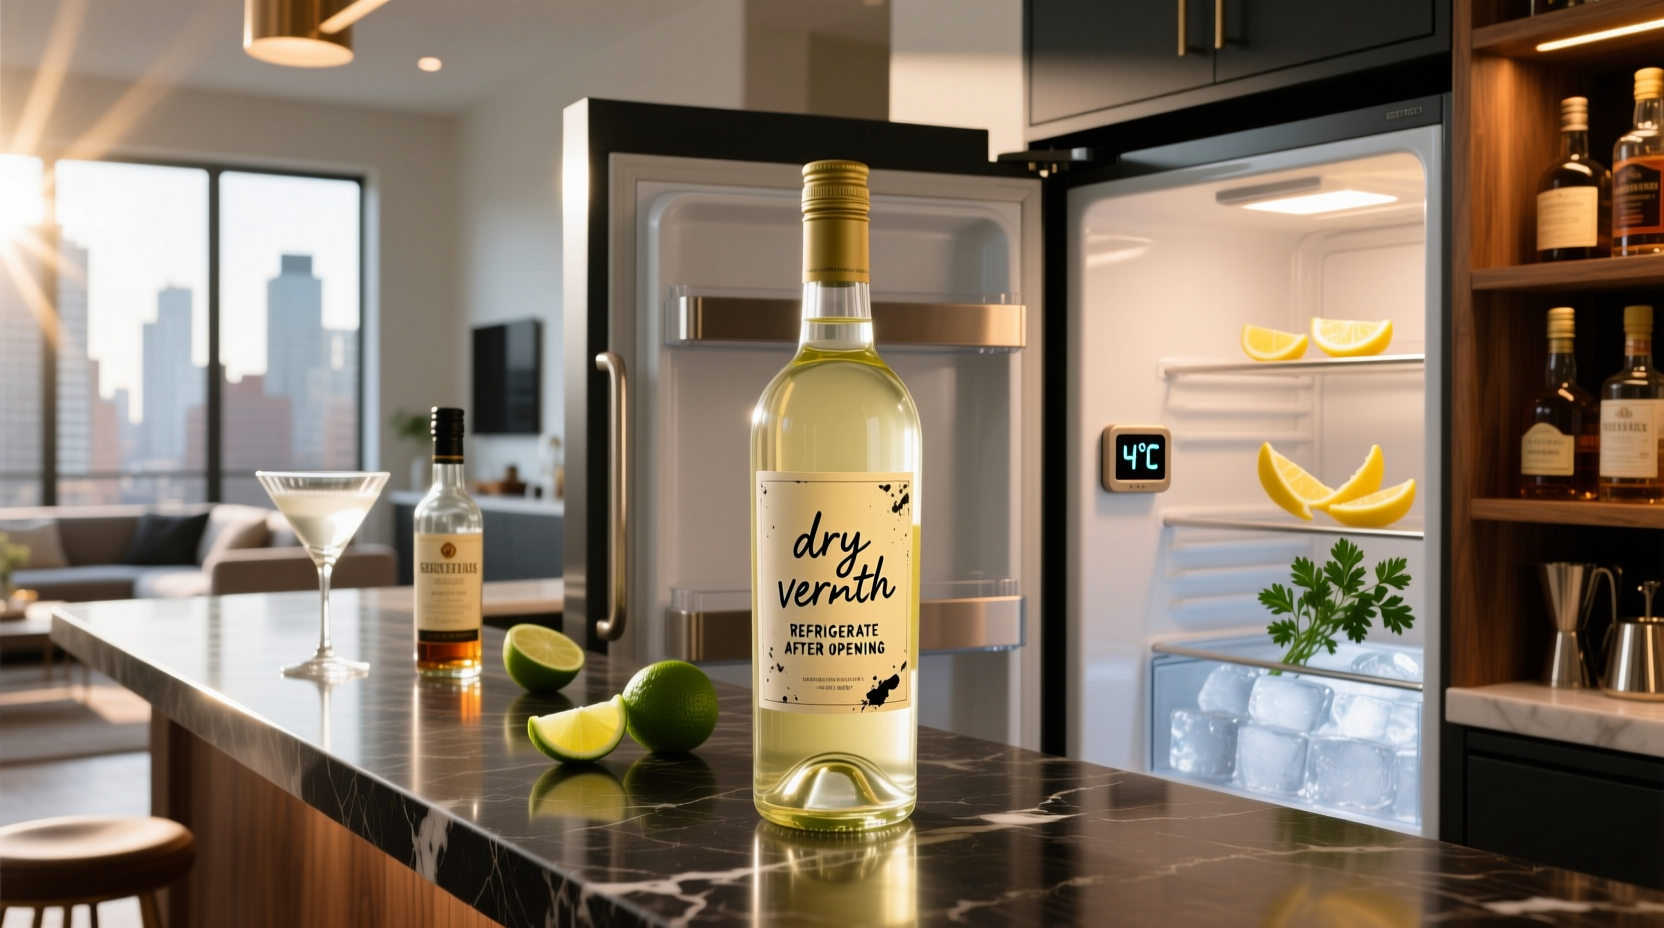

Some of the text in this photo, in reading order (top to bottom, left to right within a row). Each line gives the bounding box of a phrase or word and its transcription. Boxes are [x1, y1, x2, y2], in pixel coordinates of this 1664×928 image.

[1123, 442, 1160, 470] 4°C
[793, 511, 871, 578] dry
[790, 623, 879, 638] REFRIGERATE
[784, 641, 885, 656] AFTER OPENING
